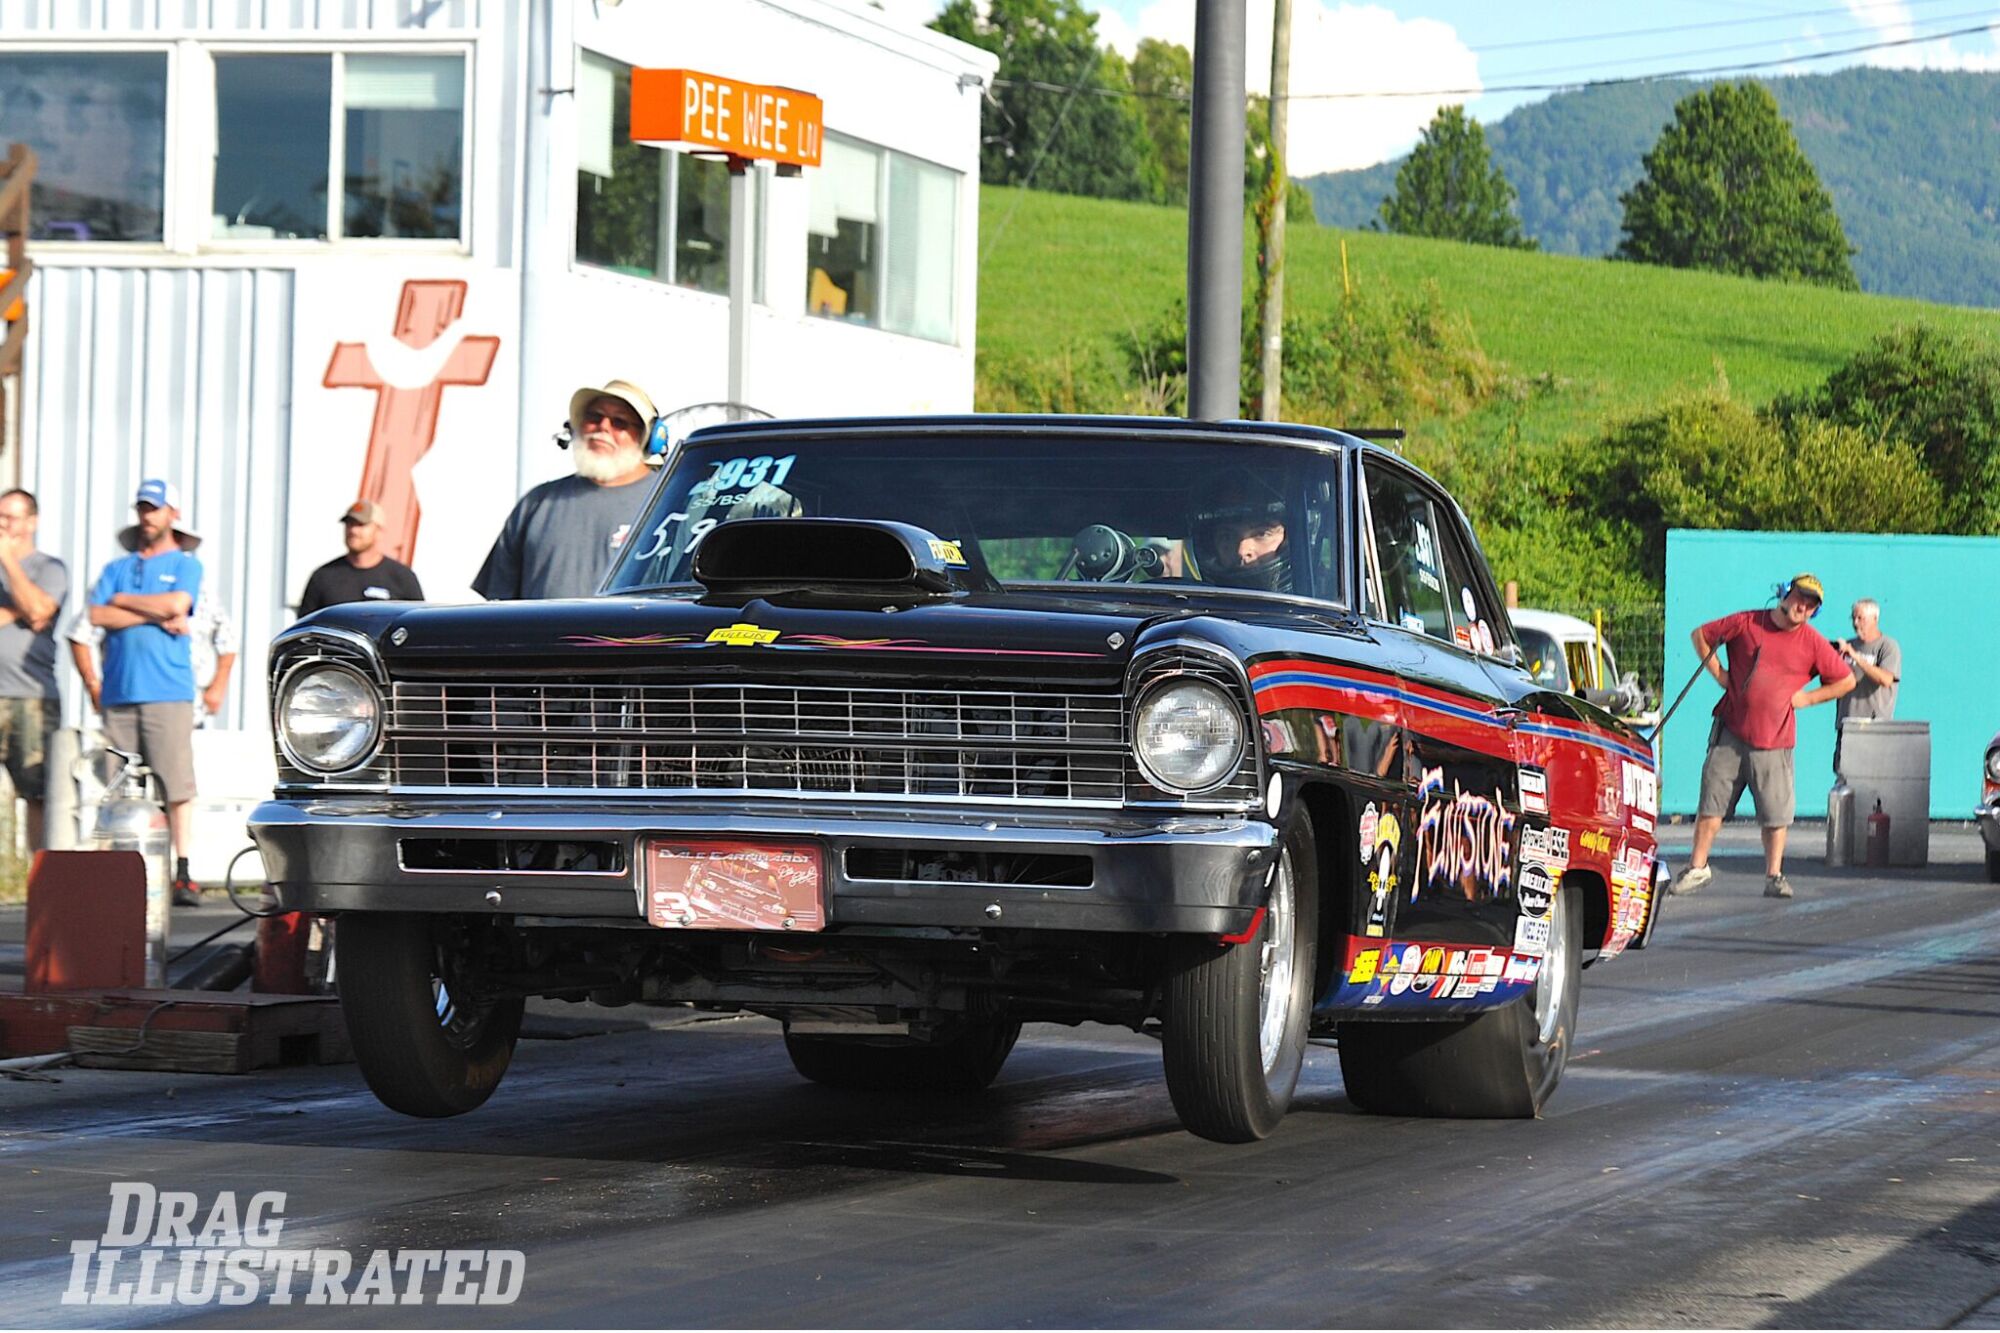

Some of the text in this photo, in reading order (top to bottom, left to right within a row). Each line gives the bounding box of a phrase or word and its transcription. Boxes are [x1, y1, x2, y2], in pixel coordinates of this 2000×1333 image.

[684, 77, 819, 159] PEE WEE LN
[653, 891, 698, 922] 3
